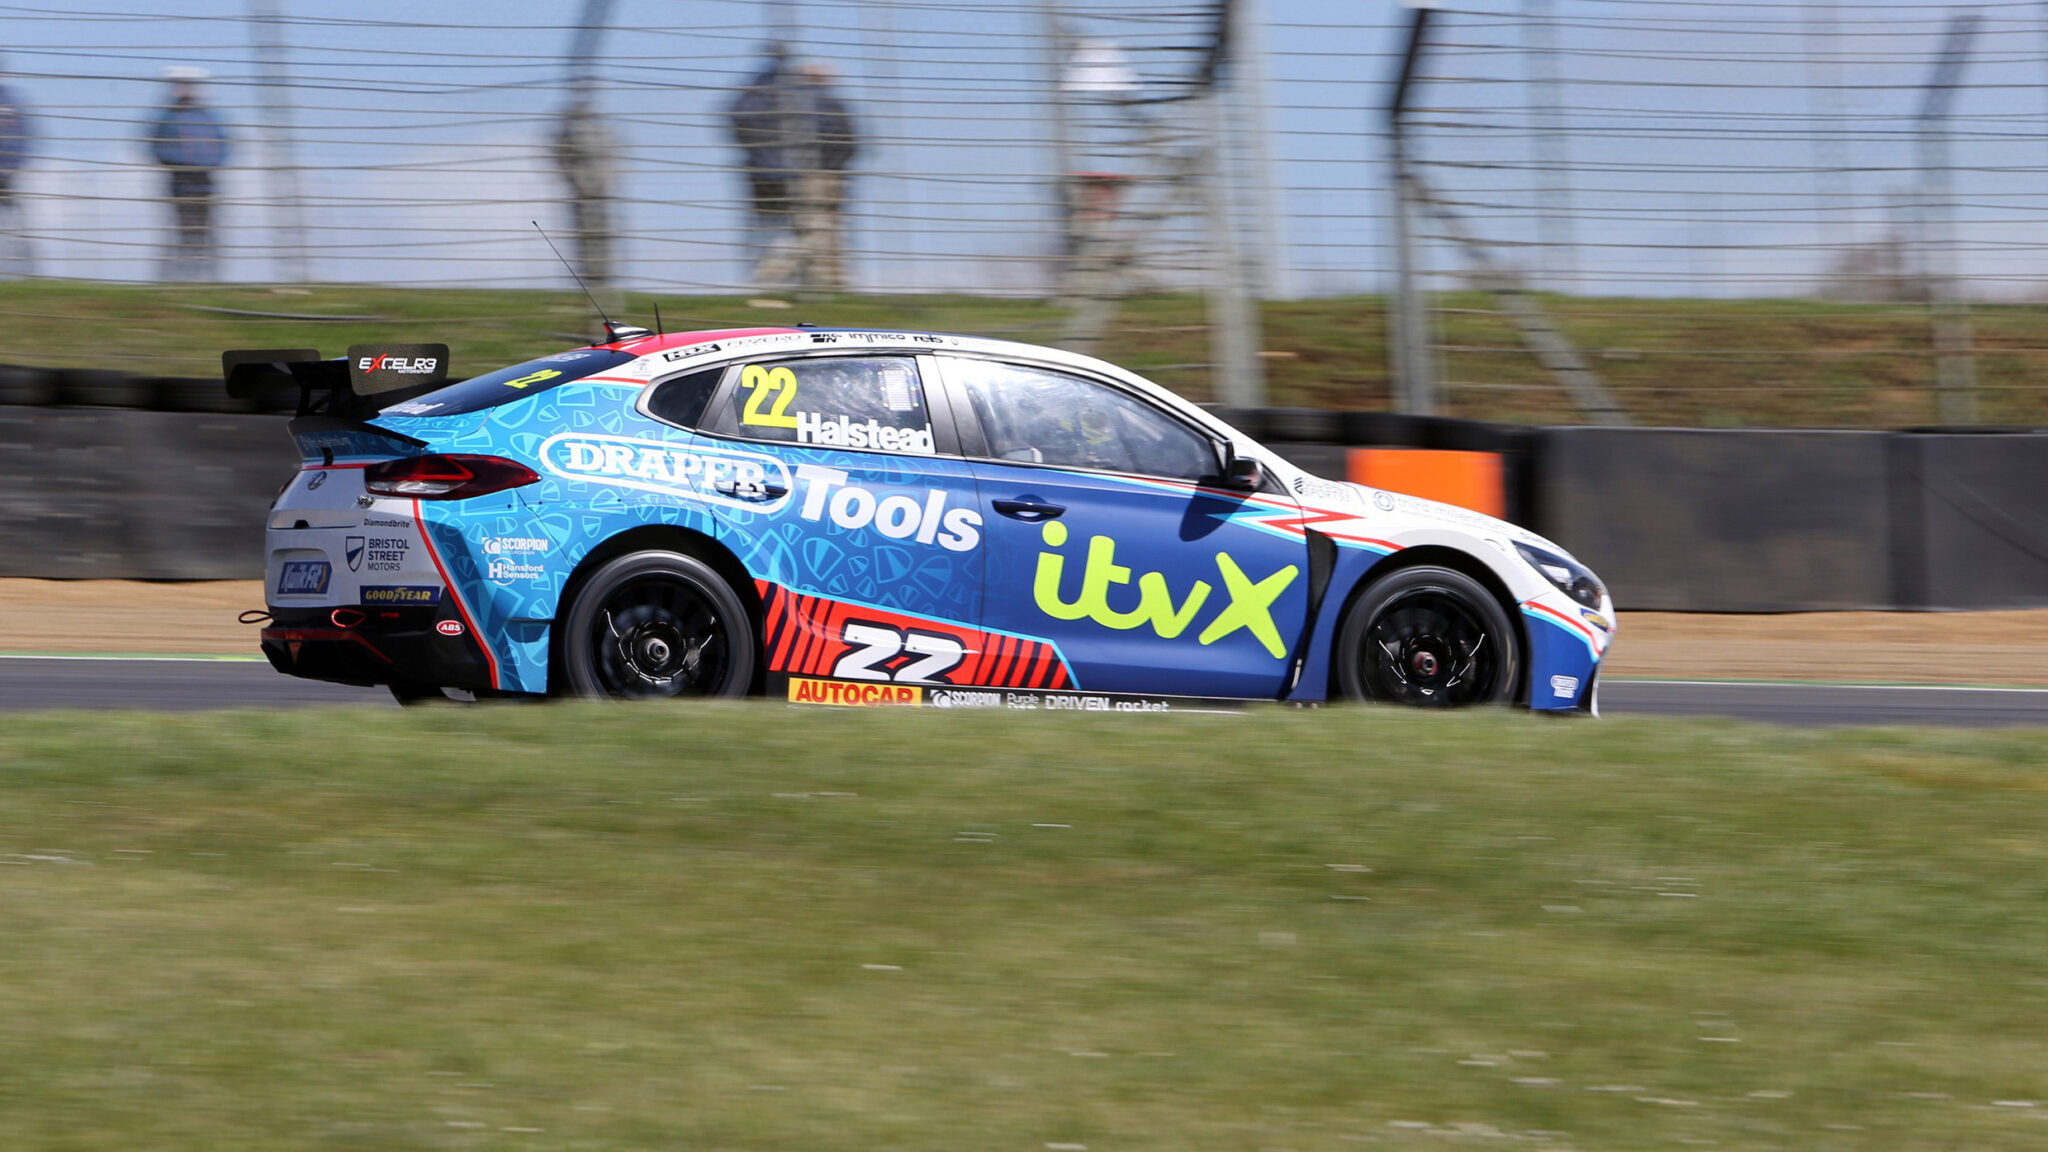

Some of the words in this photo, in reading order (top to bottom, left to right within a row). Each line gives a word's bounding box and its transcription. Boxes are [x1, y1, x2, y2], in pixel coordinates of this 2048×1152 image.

[359, 353, 438, 374] EXCELR3
[741, 365, 798, 429] 22
[796, 411, 936, 454] Halstead
[564, 442, 768, 496] DRAPER
[794, 463, 984, 552] Tools
[368, 538, 410, 549] BRISTOL
[502, 537, 548, 551] SCORPION
[368, 551, 405, 561] STREET
[368, 562, 400, 571] MOTORS
[503, 564, 544, 572] Hansford
[503, 571, 539, 579] Sensors
[365, 587, 431, 602] GOODYEAR
[1033, 520, 1298, 659] itvX
[440, 623, 461, 632] ABS
[832, 622, 968, 684] 22
[796, 680, 913, 706] AUTOCAR
[952, 691, 1001, 707] SCORPION
[1007, 692, 1039, 705] Purple
[1045, 695, 1110, 711] DRIVEN
